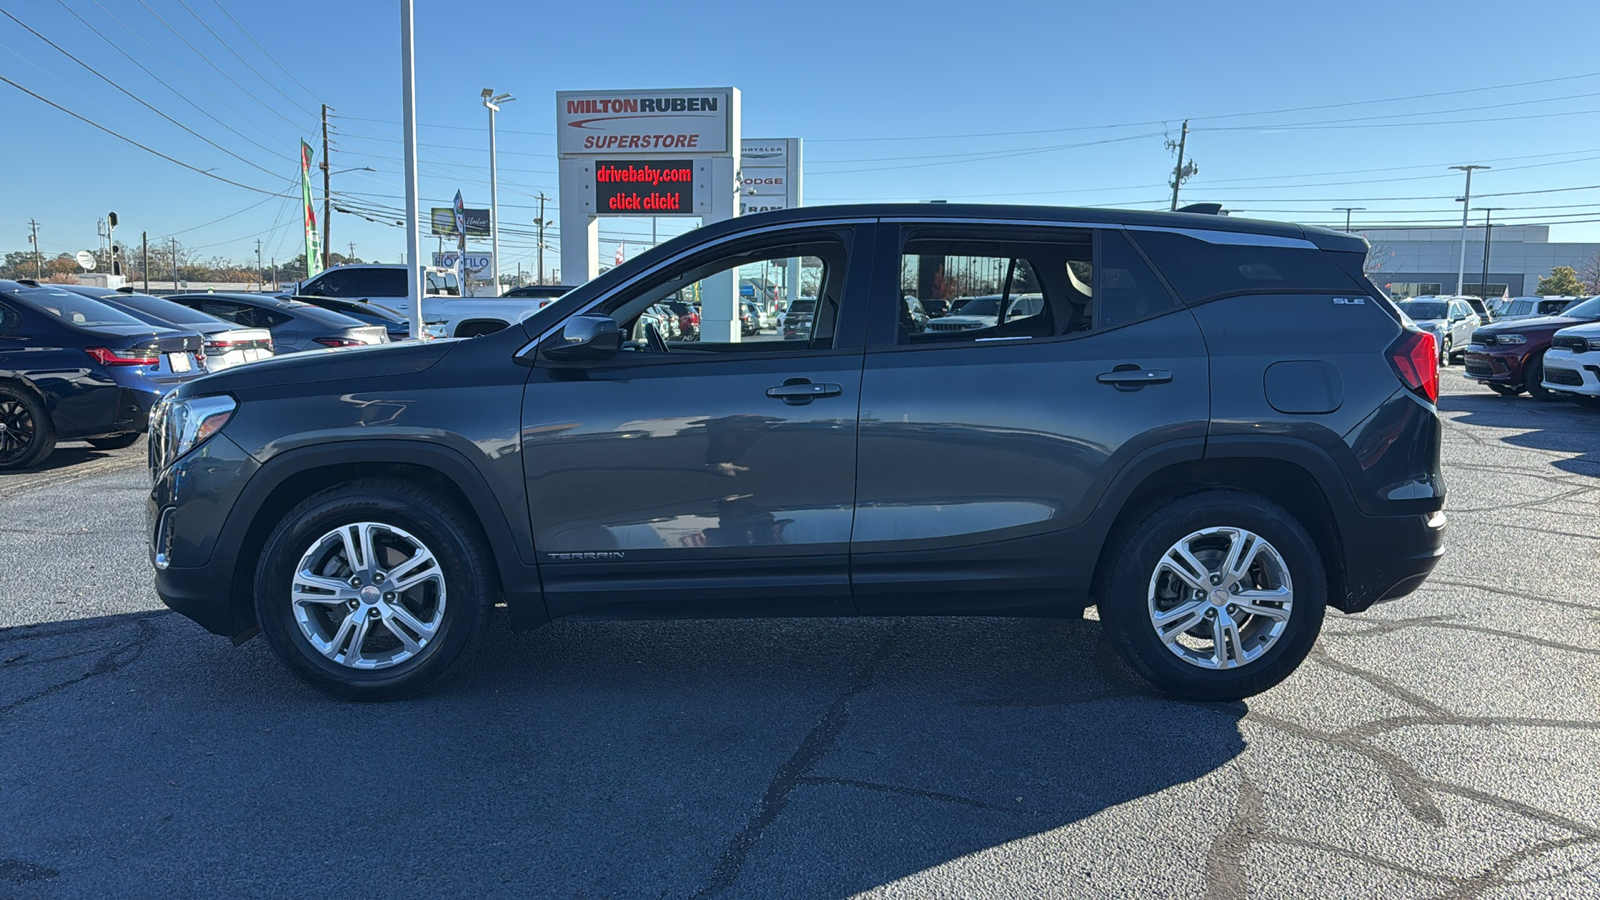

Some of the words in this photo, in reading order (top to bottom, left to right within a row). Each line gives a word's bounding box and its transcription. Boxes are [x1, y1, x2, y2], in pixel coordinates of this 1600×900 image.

[567, 98, 638, 114] MILTON
[640, 97, 718, 113] RUBEN
[583, 134, 700, 149] SUPERSTORE
[597, 165, 691, 186] drivebaby.com
[609, 192, 641, 210] click
[643, 192, 680, 210] click!
[435, 257, 489, 268] HOTILO
[1332, 297, 1366, 305] SLE
[547, 551, 625, 560] TERRAIN
